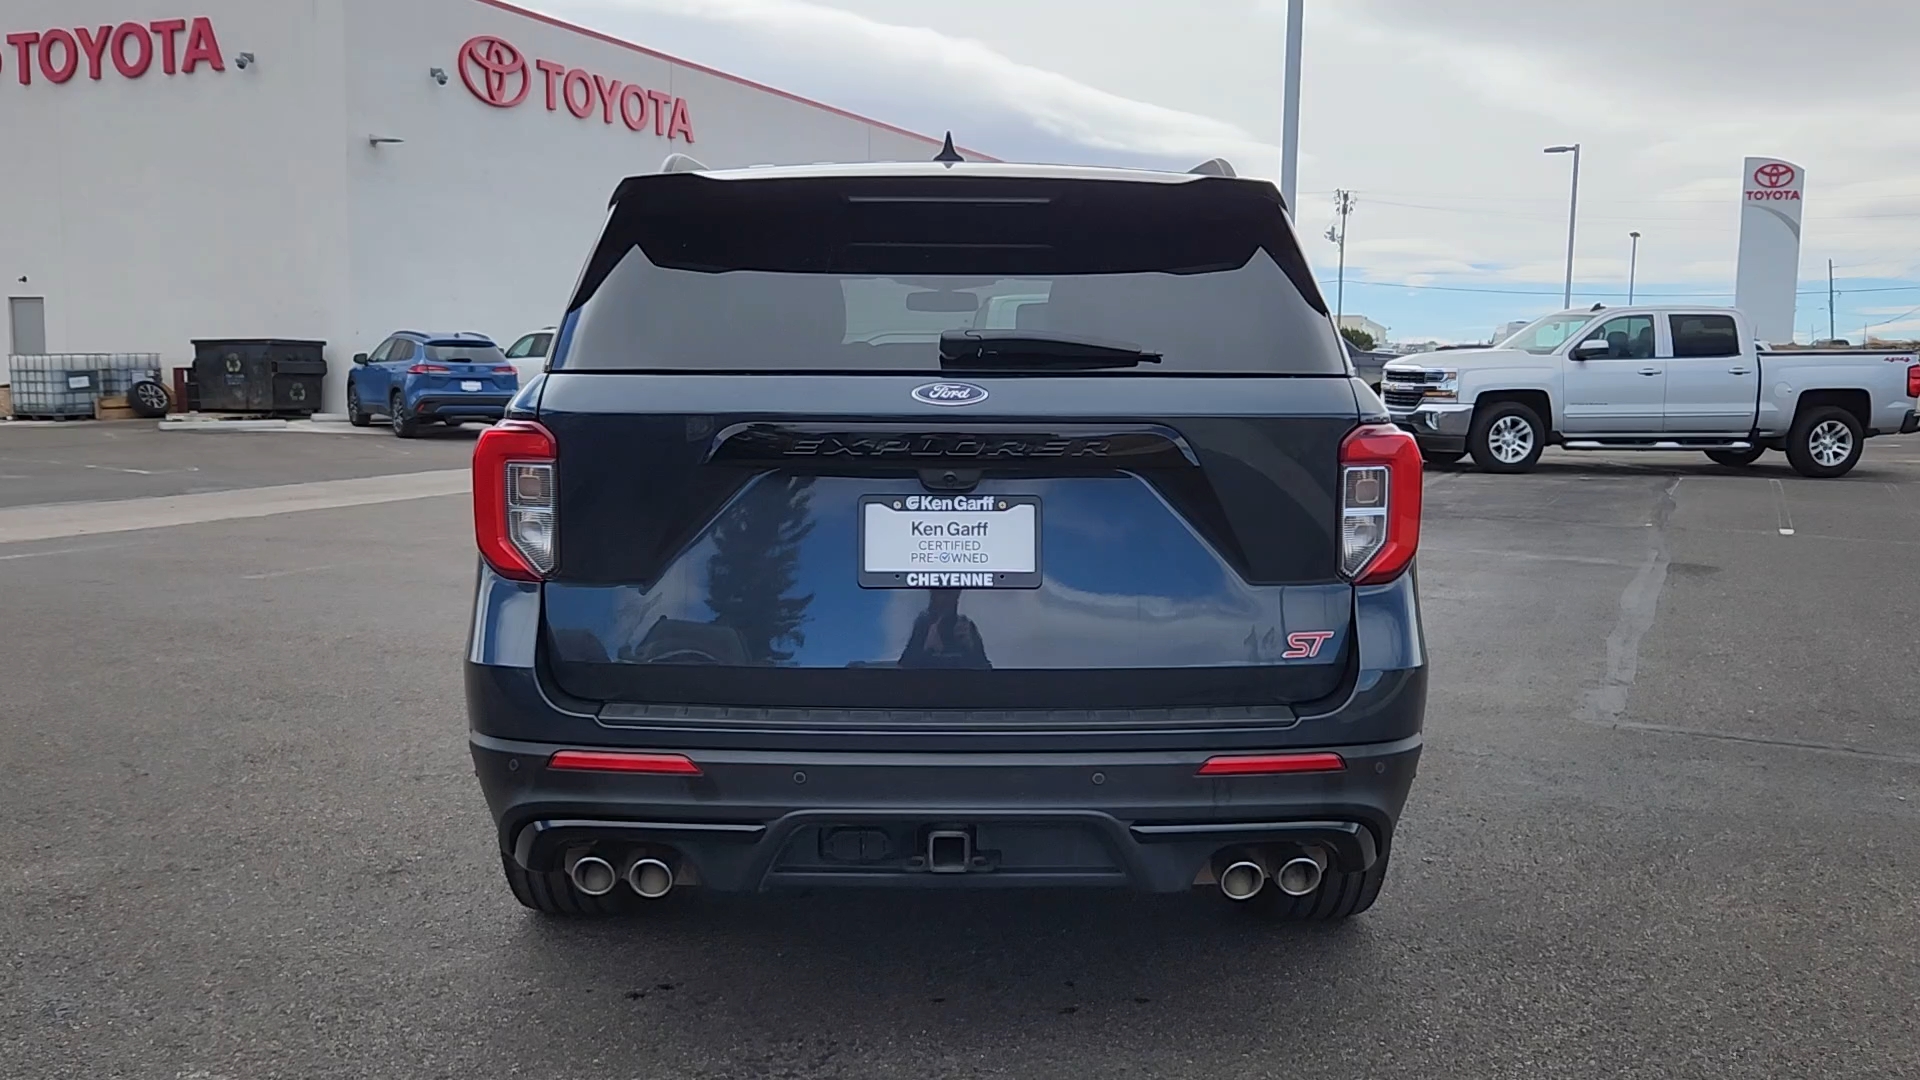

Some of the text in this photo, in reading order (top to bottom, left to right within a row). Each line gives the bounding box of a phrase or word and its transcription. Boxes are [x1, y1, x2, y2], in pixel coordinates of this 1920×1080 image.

[6, 17, 225, 85] TOYOTA
[536, 59, 695, 143] TOYOTA
[1746, 190, 1800, 201] TOYOTA
[929, 384, 970, 399] Ford
[783, 438, 1111, 457] EXPLORER
[921, 496, 994, 511] Ken Garff
[911, 521, 989, 536] Ken Garff
[918, 540, 981, 551] CERTIFIED
[906, 573, 994, 587] CHEYENNE
[1281, 631, 1335, 659] ST
